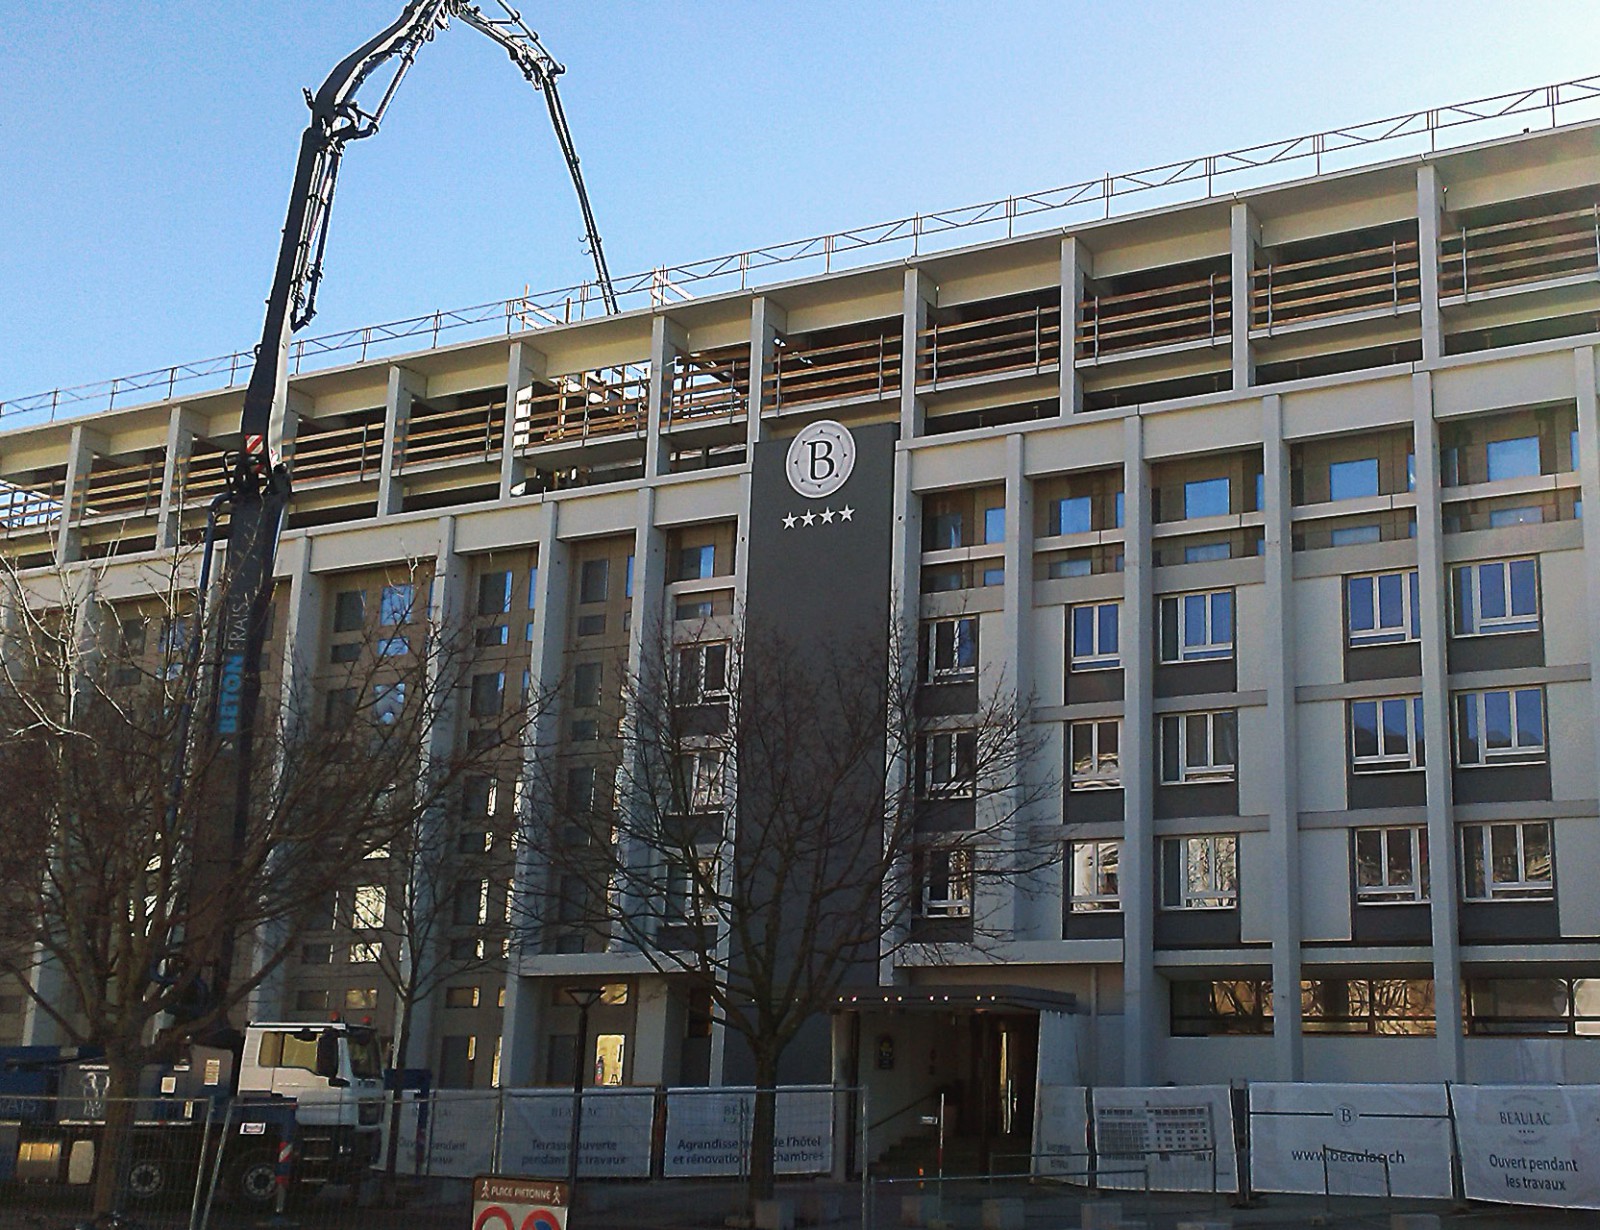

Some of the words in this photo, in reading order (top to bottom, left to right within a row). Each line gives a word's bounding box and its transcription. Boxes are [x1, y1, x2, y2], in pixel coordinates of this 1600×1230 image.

[807, 440, 835, 480] B
[217, 654, 245, 733] BETON
[1339, 1107, 1352, 1123] B
[1499, 1111, 1551, 1126] BEAULAC
[786, 1135, 821, 1147] l'hôtel
[521, 1154, 564, 1167] pendant
[585, 1155, 626, 1165] travaux
[672, 1154, 683, 1164] et
[686, 1152, 742, 1165] rénovatio
[1291, 1148, 1405, 1164] www.beaulacch
[1489, 1153, 1527, 1169] Ouvert
[1530, 1156, 1578, 1172] pendant
[1505, 1174, 1521, 1188] les
[1522, 1176, 1566, 1191] travaux
[491, 1185, 513, 1198] PLACE
